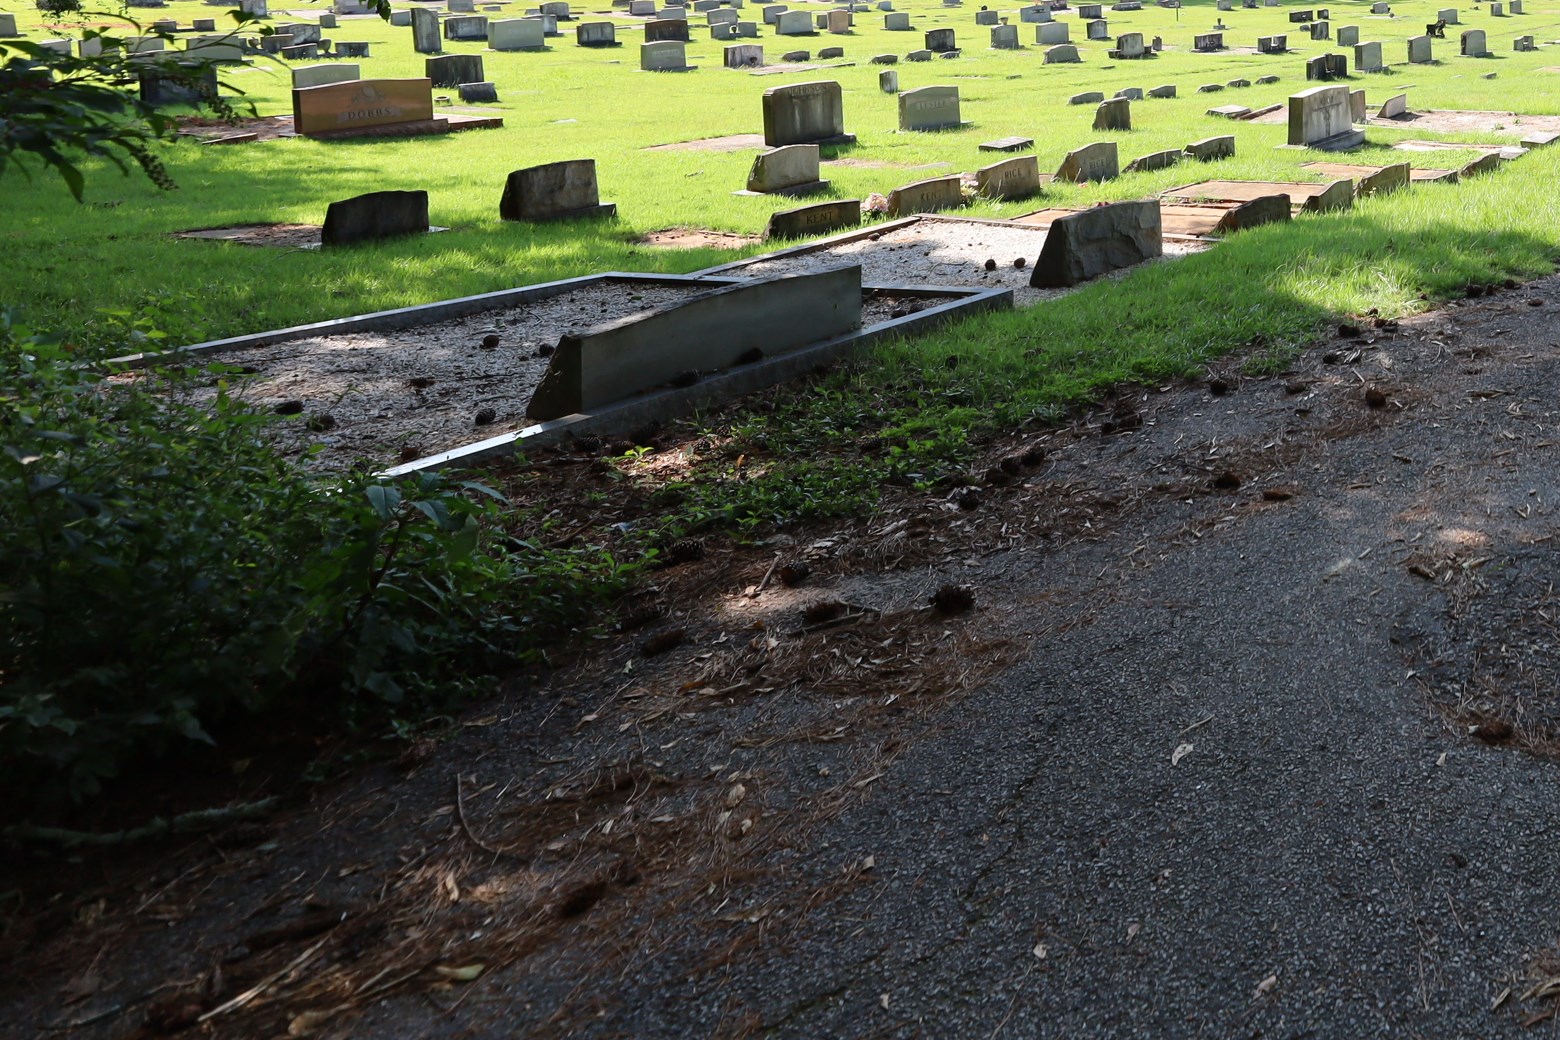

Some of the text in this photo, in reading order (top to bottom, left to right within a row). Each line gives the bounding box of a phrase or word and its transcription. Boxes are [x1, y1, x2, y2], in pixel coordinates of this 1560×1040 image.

[347, 109, 391, 119] DOBBS
[1089, 159, 1105, 168] RICE
[1004, 167, 1022, 179] RICE
[921, 191, 942, 202] KENT
[806, 212, 833, 225] KENT
